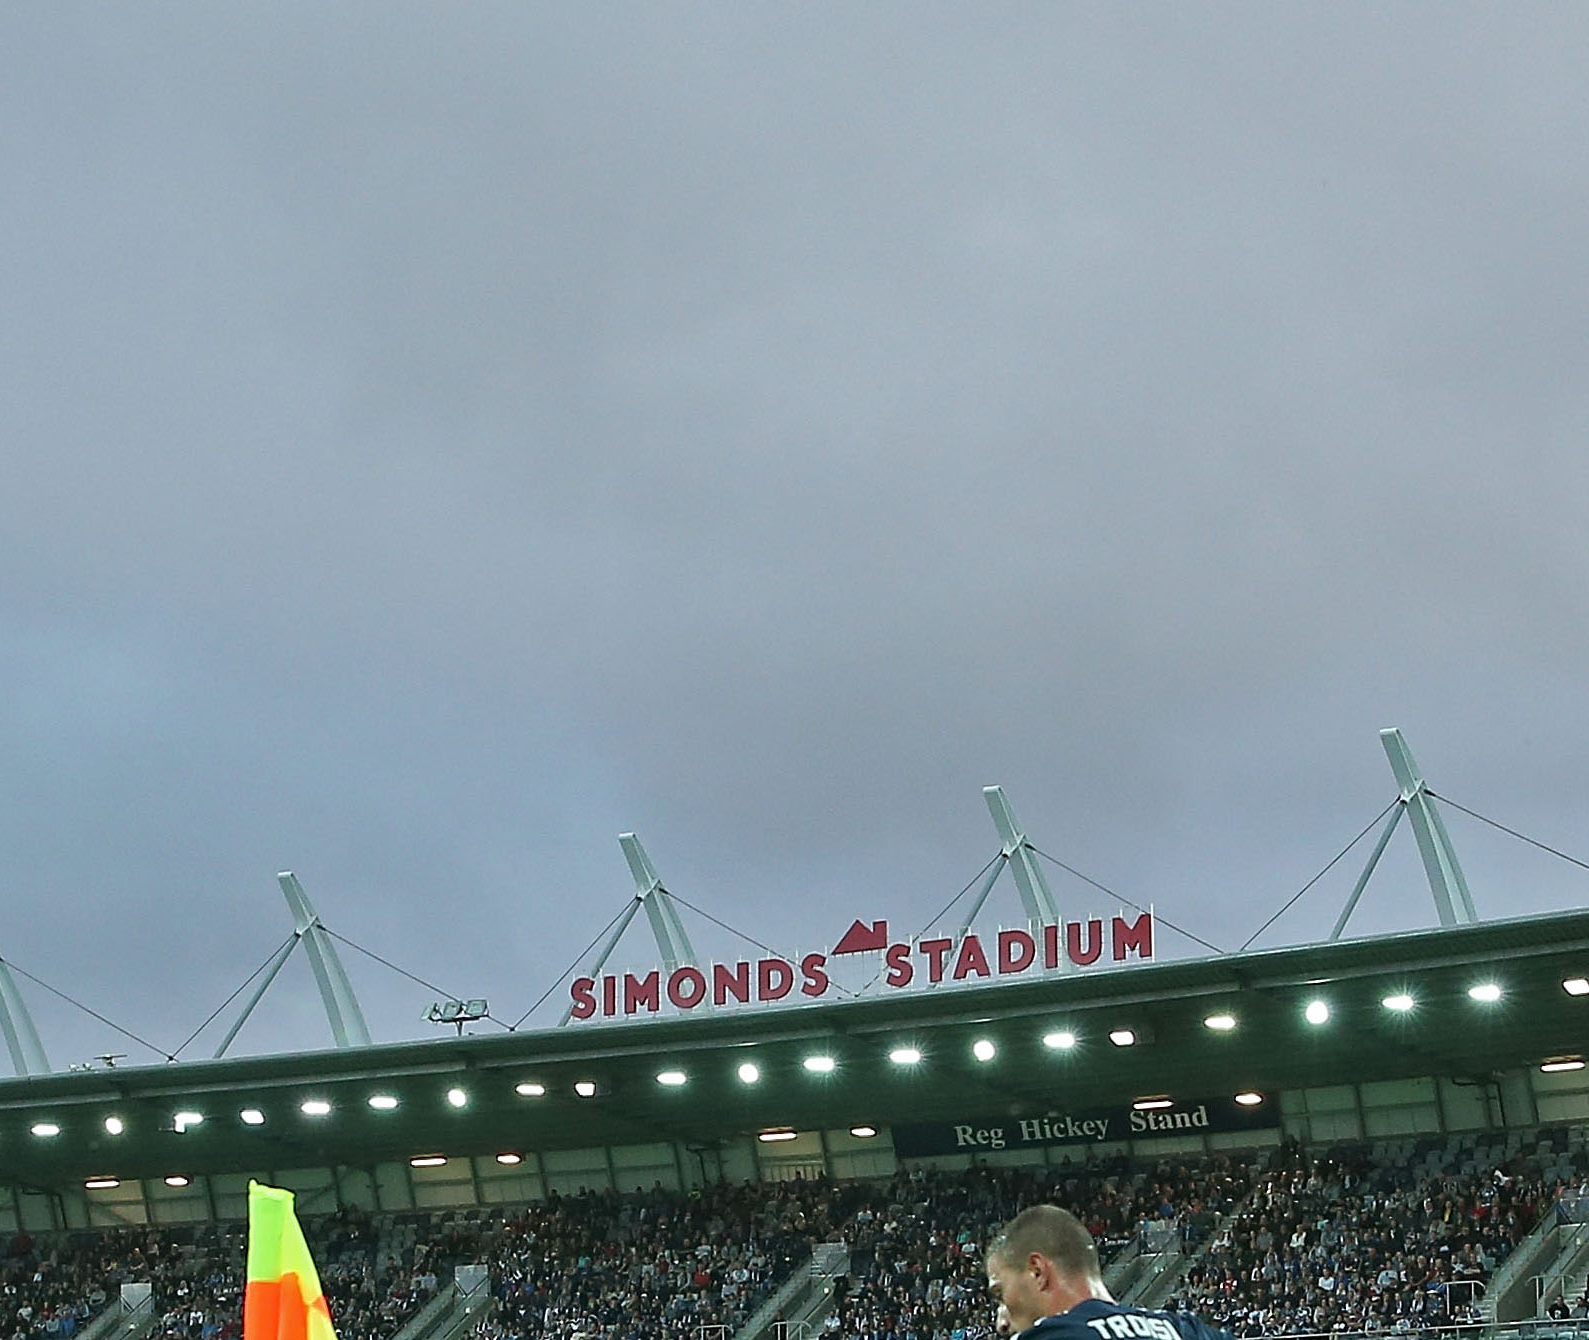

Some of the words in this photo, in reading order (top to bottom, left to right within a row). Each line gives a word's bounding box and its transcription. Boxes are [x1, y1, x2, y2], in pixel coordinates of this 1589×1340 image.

[569, 953, 830, 1020] SIMONDS
[885, 912, 1153, 988] STADIUM
[953, 1125, 1006, 1148] Reg
[1019, 1116, 1109, 1141] Hickey
[1130, 1106, 1209, 1133] Stand
